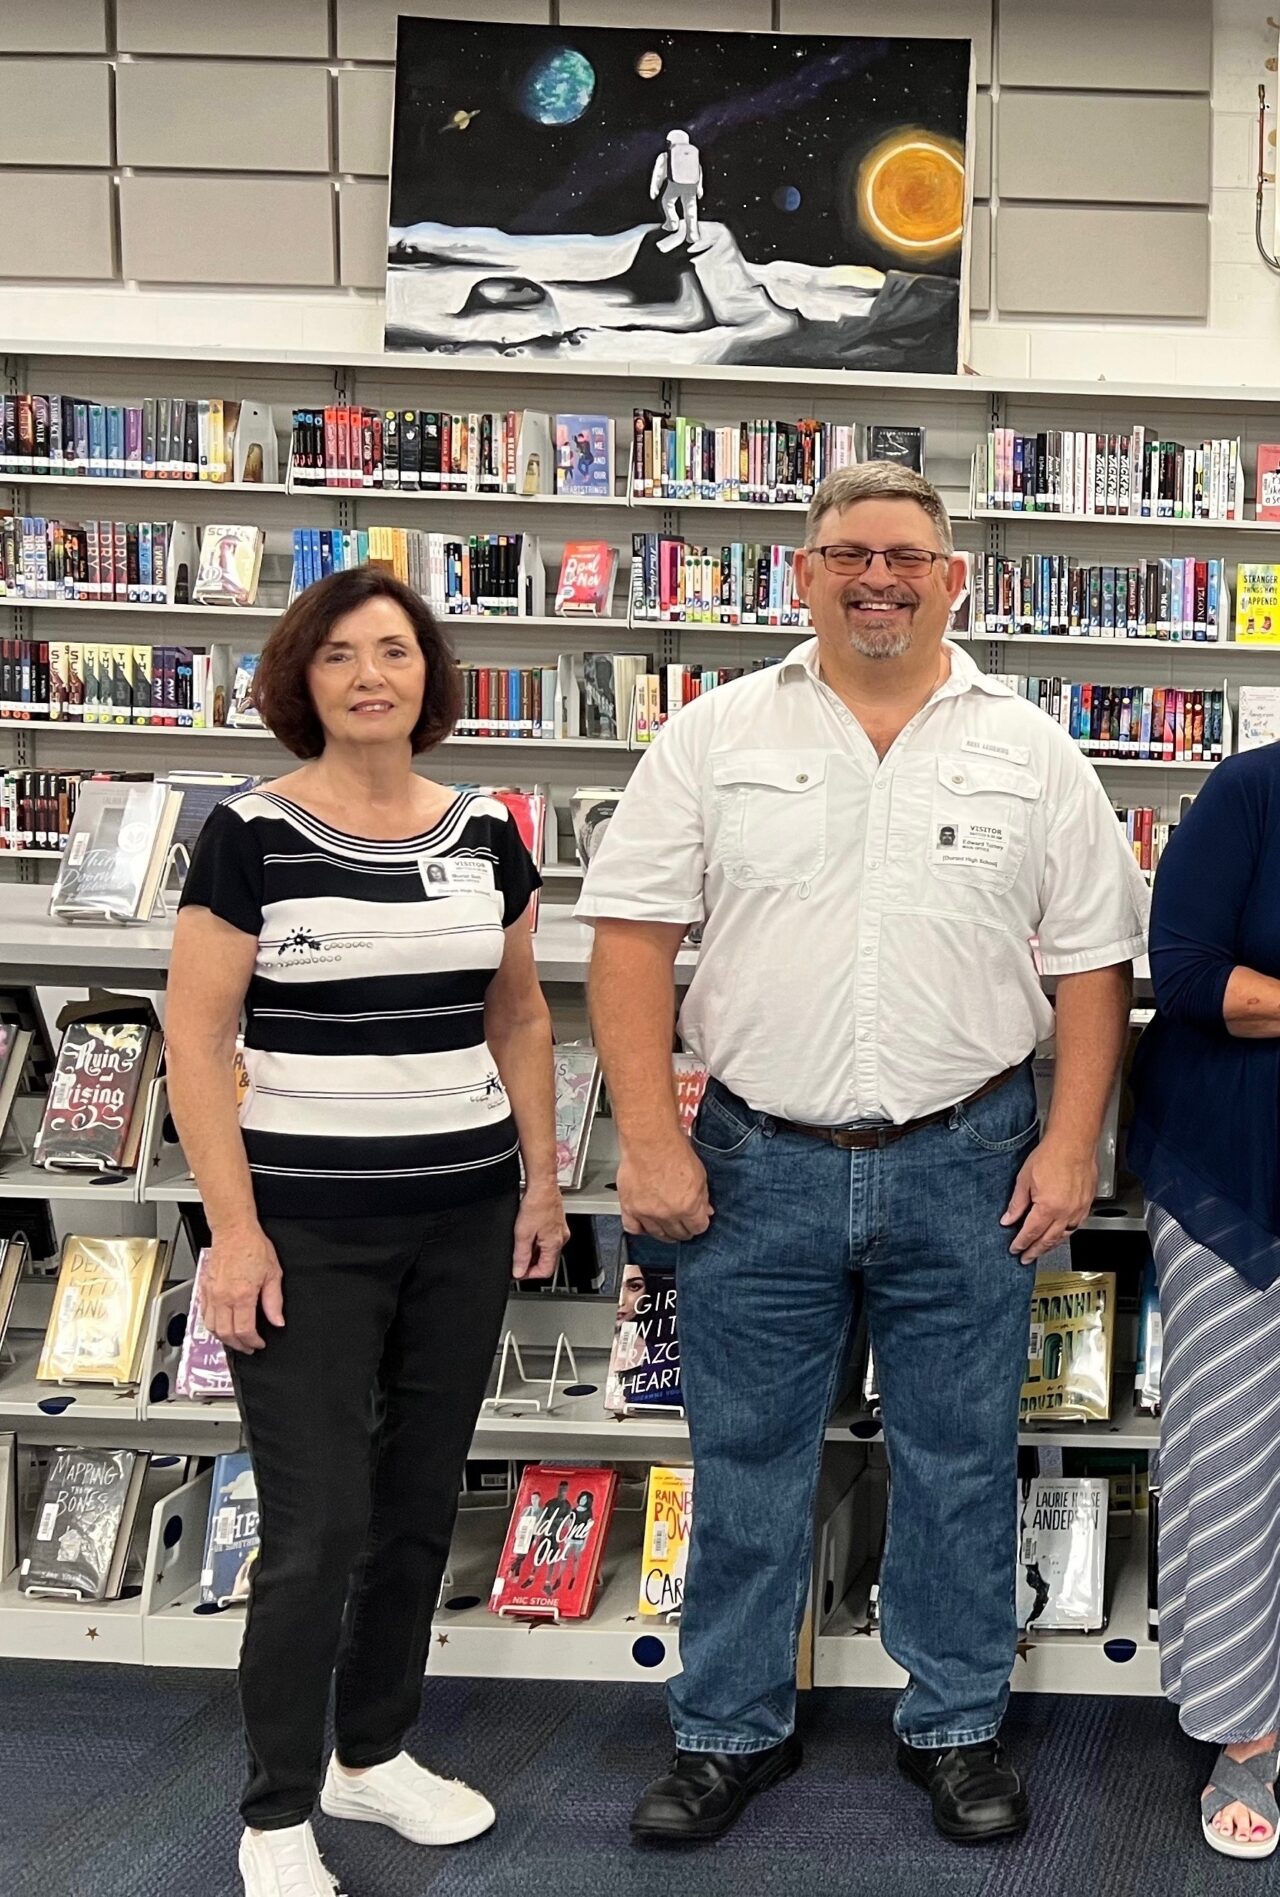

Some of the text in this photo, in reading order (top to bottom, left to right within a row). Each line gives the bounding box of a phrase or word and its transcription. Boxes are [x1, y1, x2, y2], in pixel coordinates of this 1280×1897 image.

[87, 533, 98, 569] DRY
[101, 534, 112, 570] DRY
[115, 534, 126, 571] DRY
[1243, 574, 1278, 584] STRANGER
[1248, 597, 1278, 606] APPENED
[970, 825, 1002, 835] VISITOR
[634, 1290, 678, 1315] GIR
[625, 1341, 681, 1370] RAZO
[50, 1456, 118, 1484] MAPPING
[56, 1489, 110, 1518] BONES
[655, 1489, 692, 1515] RAINB
[1036, 1491, 1068, 1508] LAURIE
[556, 1511, 595, 1545] One
[653, 1501, 692, 1543] ROW
[534, 1537, 569, 1567] Out
[513, 1596, 561, 1608] NIC STONE
[645, 1568, 685, 1607] CAR
